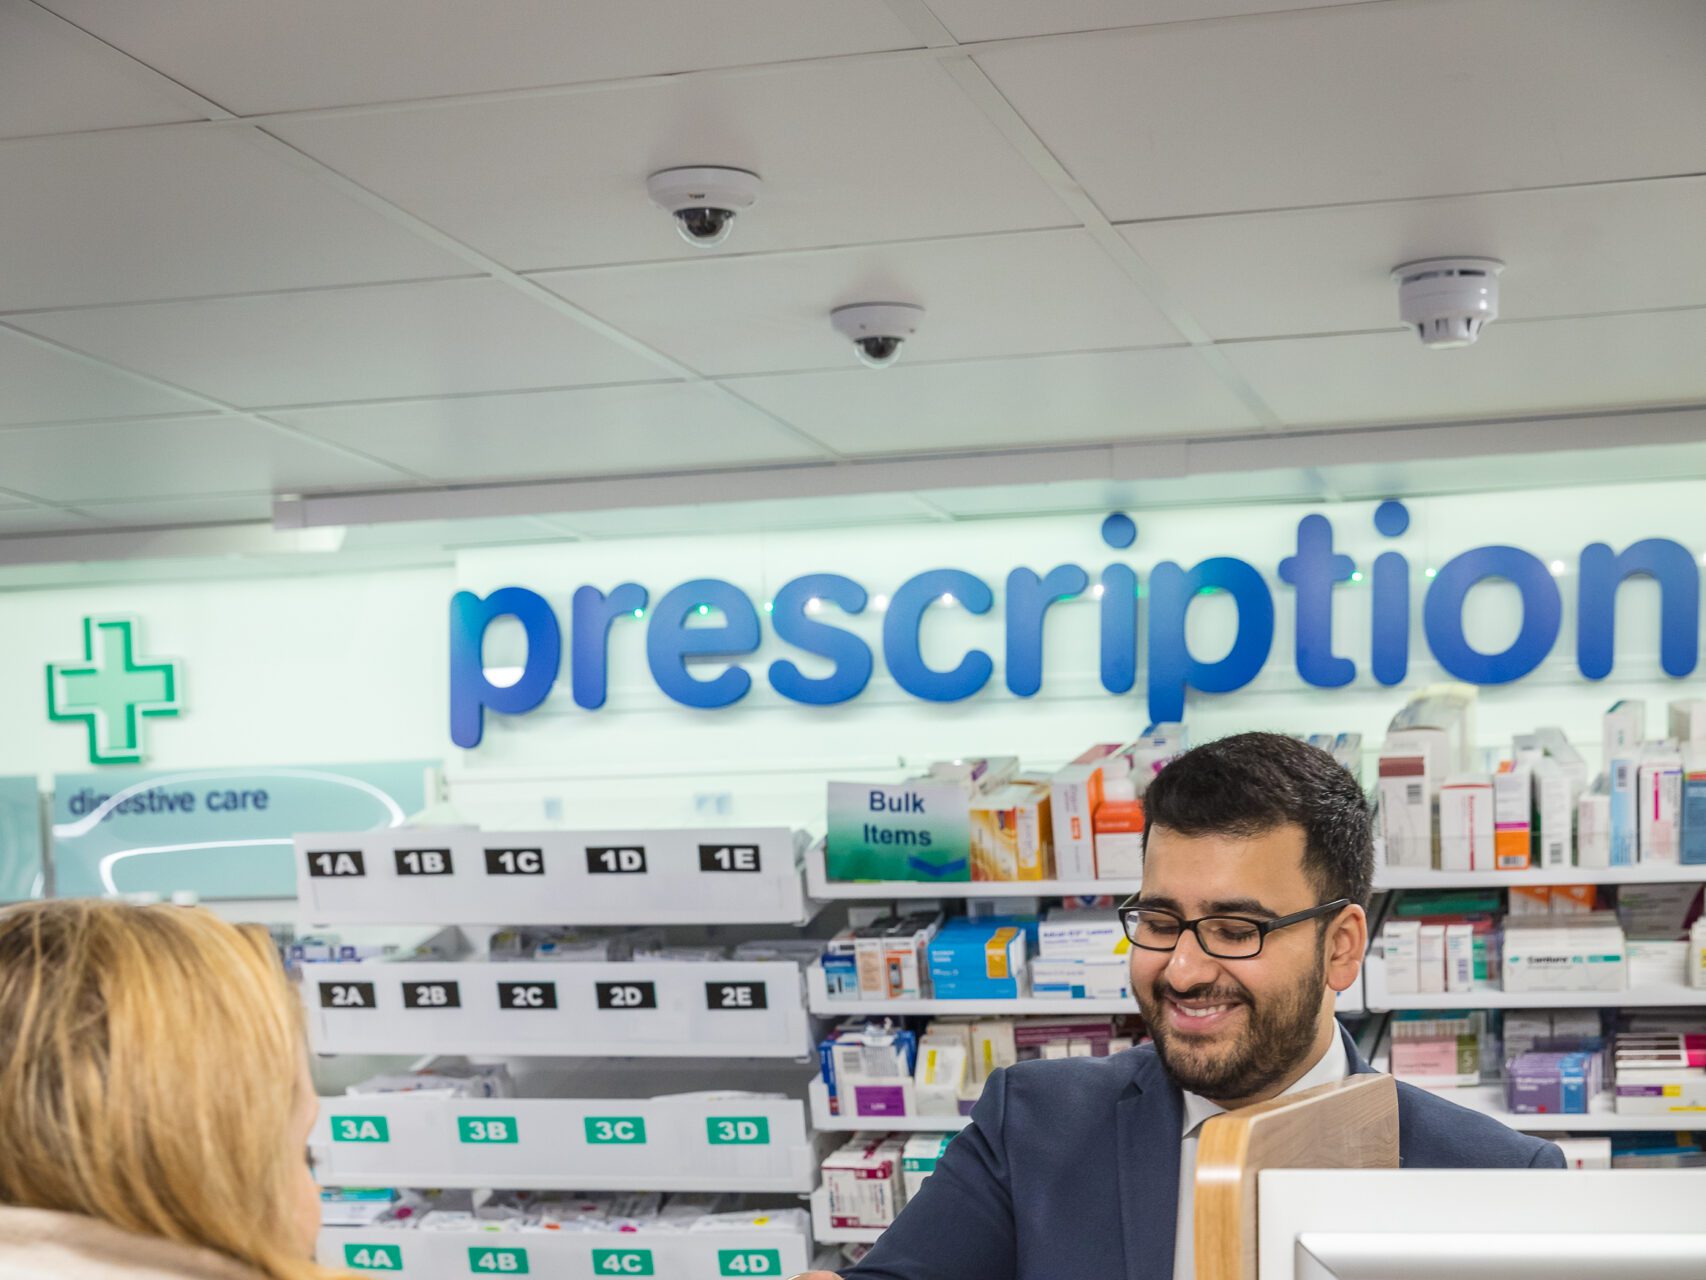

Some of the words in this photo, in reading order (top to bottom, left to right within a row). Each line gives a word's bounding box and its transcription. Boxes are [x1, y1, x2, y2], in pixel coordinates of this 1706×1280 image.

[450, 500, 1699, 748] prescription
[68, 786, 195, 819] digestive
[205, 786, 269, 812] care
[869, 791, 925, 813] Bulk
[864, 824, 932, 847] Items
[316, 853, 359, 874] 1A
[403, 852, 445, 873] 1B
[499, 851, 541, 873] 1C
[600, 849, 643, 871] 1D
[714, 848, 755, 869] 1E
[331, 986, 366, 1005] 2A
[416, 986, 449, 1005] 2B
[512, 987, 544, 1006] 2C
[610, 987, 642, 1006] 2D
[721, 987, 752, 1006] 2E
[340, 1120, 380, 1139] 3A
[469, 1121, 507, 1140] 3B
[596, 1121, 635, 1140] 3C
[718, 1121, 758, 1141] 3D
[353, 1249, 393, 1268] 4A
[478, 1252, 517, 1271] 4B
[602, 1253, 643, 1273] 4C
[729, 1253, 770, 1273] 4D
